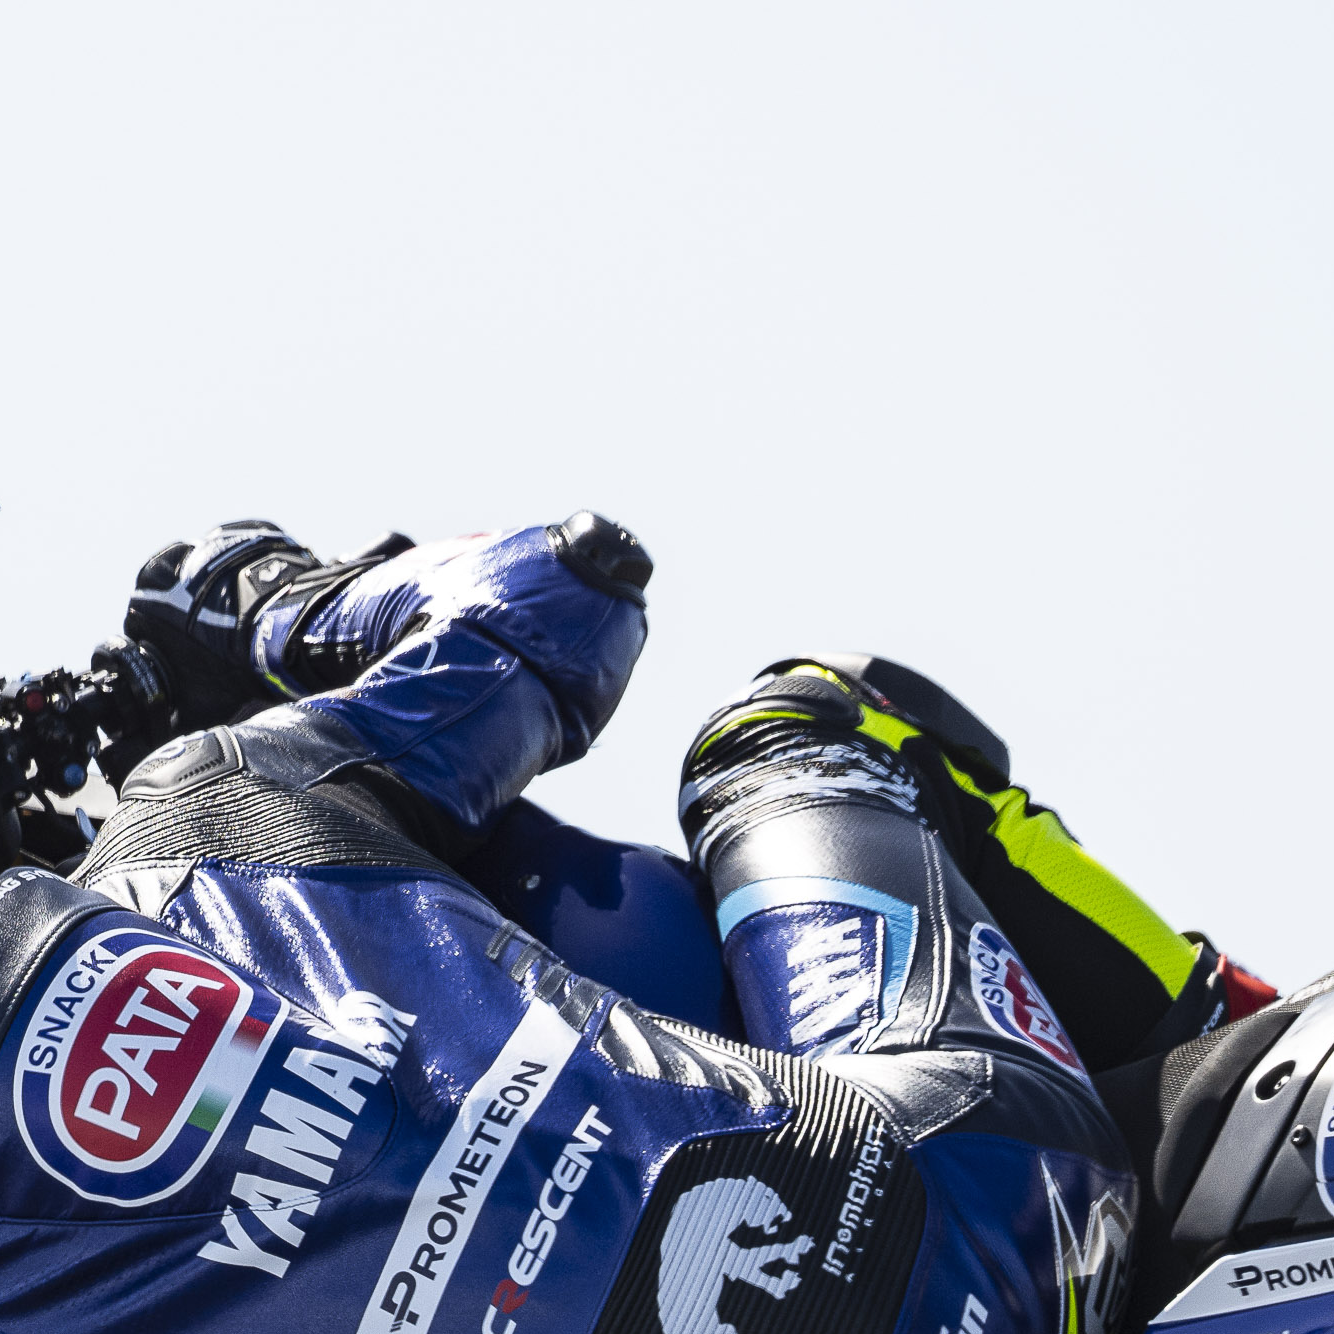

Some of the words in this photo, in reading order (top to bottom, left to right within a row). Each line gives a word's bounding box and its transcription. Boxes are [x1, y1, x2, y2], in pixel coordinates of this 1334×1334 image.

[28, 950, 116, 1070] SNACK
[74, 967, 226, 1141] PATA
[197, 990, 417, 1279] YAMAHA
[380, 1060, 548, 1333] PROMETEON
